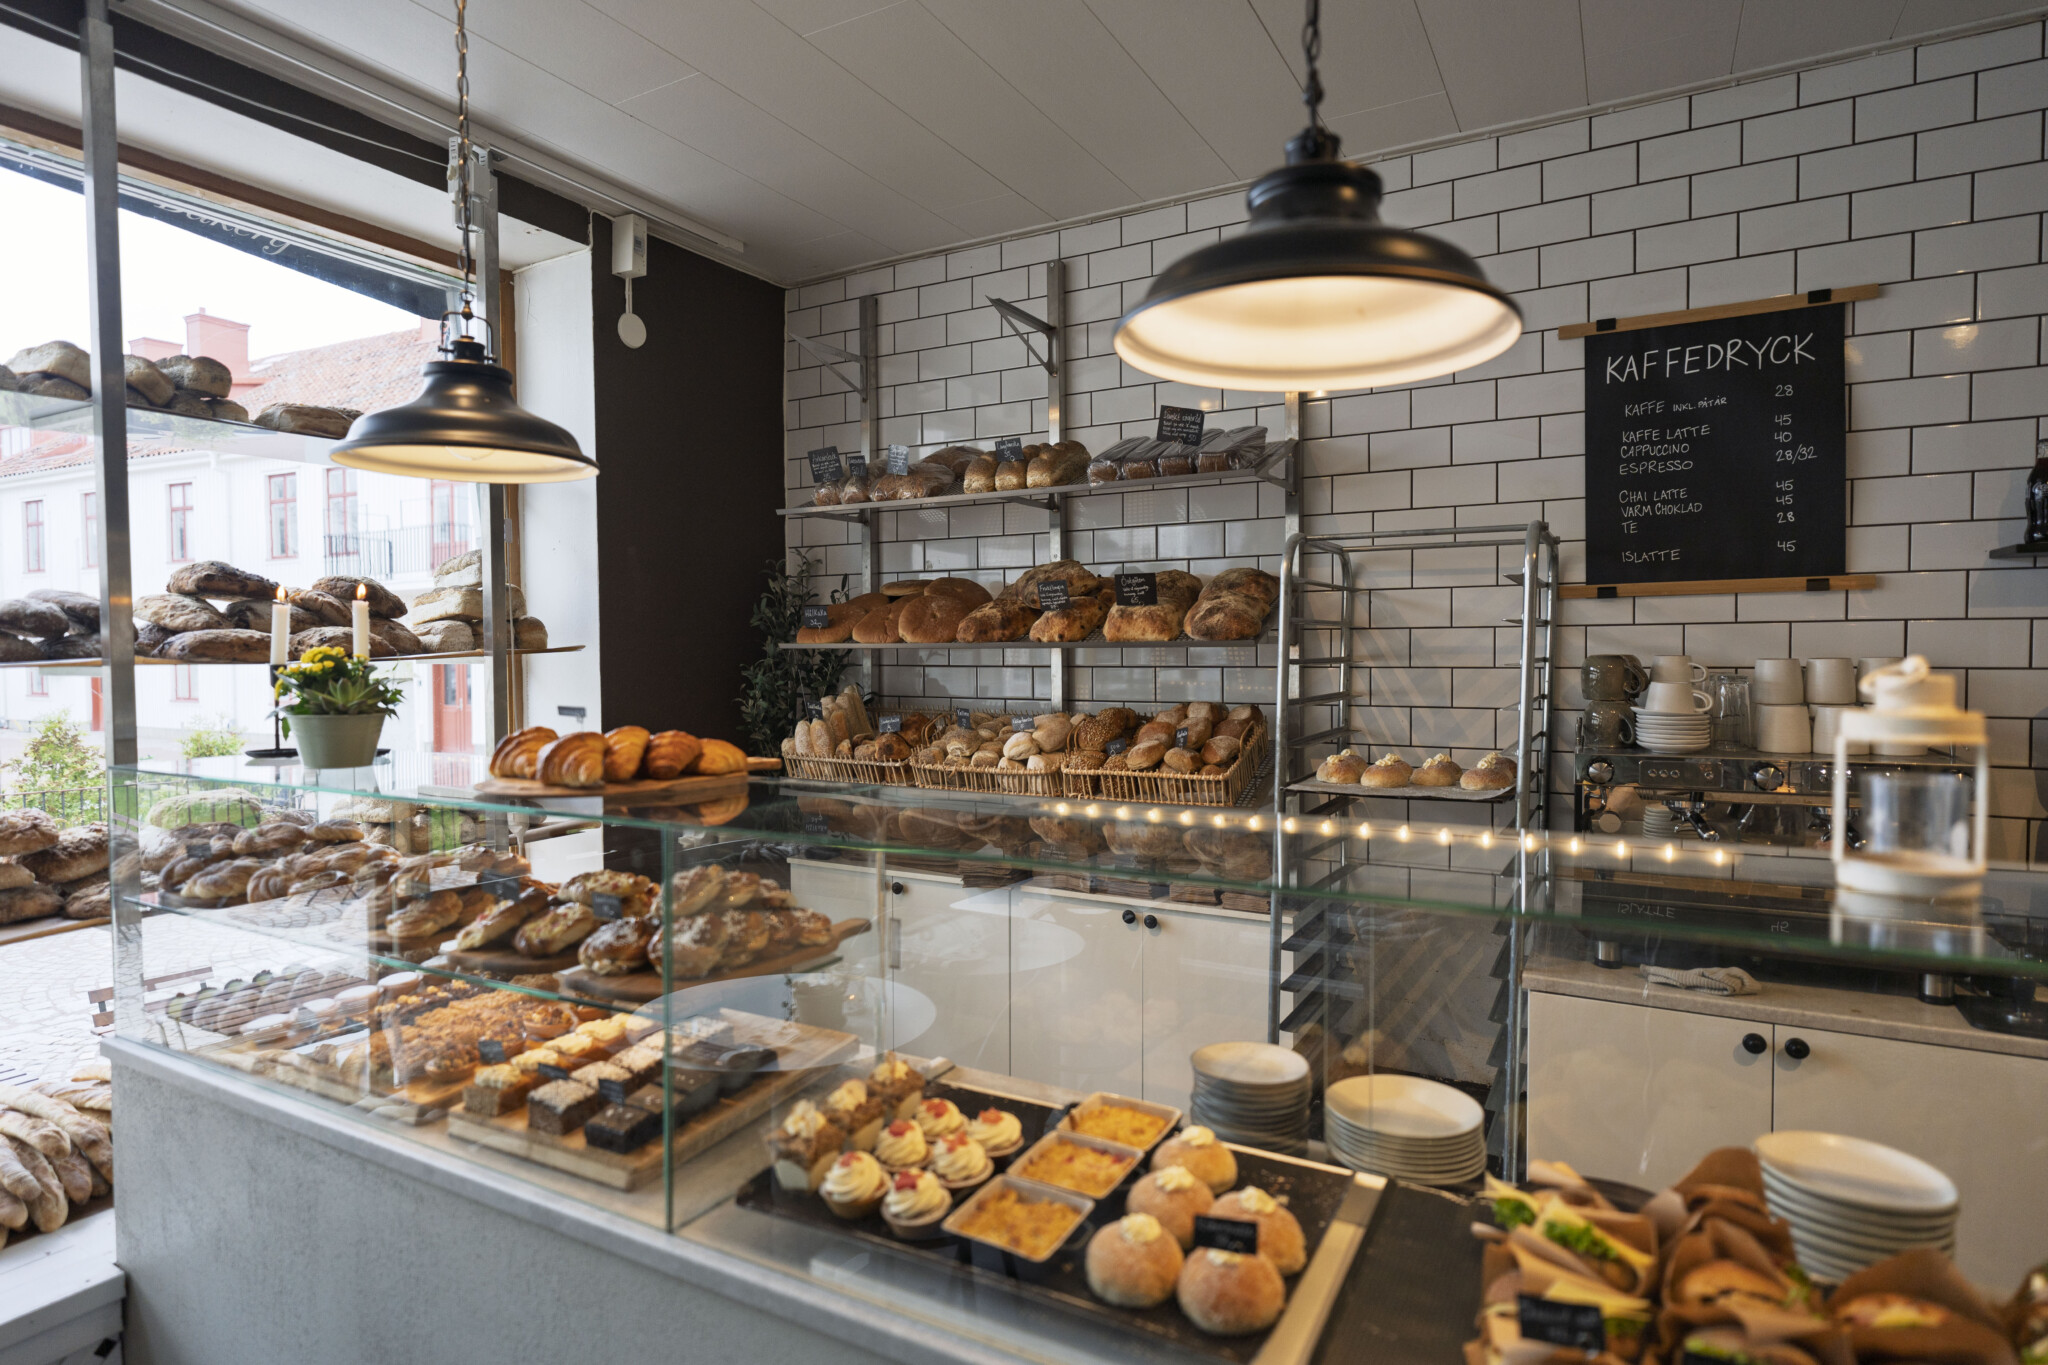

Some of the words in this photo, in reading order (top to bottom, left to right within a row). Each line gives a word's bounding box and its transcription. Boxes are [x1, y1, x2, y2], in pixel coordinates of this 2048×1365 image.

[1606, 332, 1816, 385] KAFFEDRYCK
[1625, 400, 1665, 418] KAFFE
[1673, 402, 1696, 412] INKL.
[1697, 395, 1727, 408] PÅTÅR
[1775, 384, 1794, 397] 28
[1622, 428, 1661, 443] KAFFE
[1666, 424, 1710, 440] LATTE
[1774, 413, 1792, 426] 45
[1620, 443, 1690, 459] CAPPUCCINO
[1774, 431, 1792, 443] 40
[1619, 460, 1694, 476] ESPRESSO
[1776, 443, 1818, 465] 28/32
[1619, 489, 1647, 504] CHAI
[1653, 487, 1688, 501] LATTE
[1775, 479, 1794, 491] 45
[1621, 504, 1652, 518] VARM
[1655, 502, 1703, 515] CHOKLAD
[1775, 494, 1793, 505] 45
[1621, 520, 1638, 534] TE
[1776, 511, 1795, 524] 28
[1621, 548, 1681, 564] ISLATTE
[1777, 540, 1797, 552] 45
